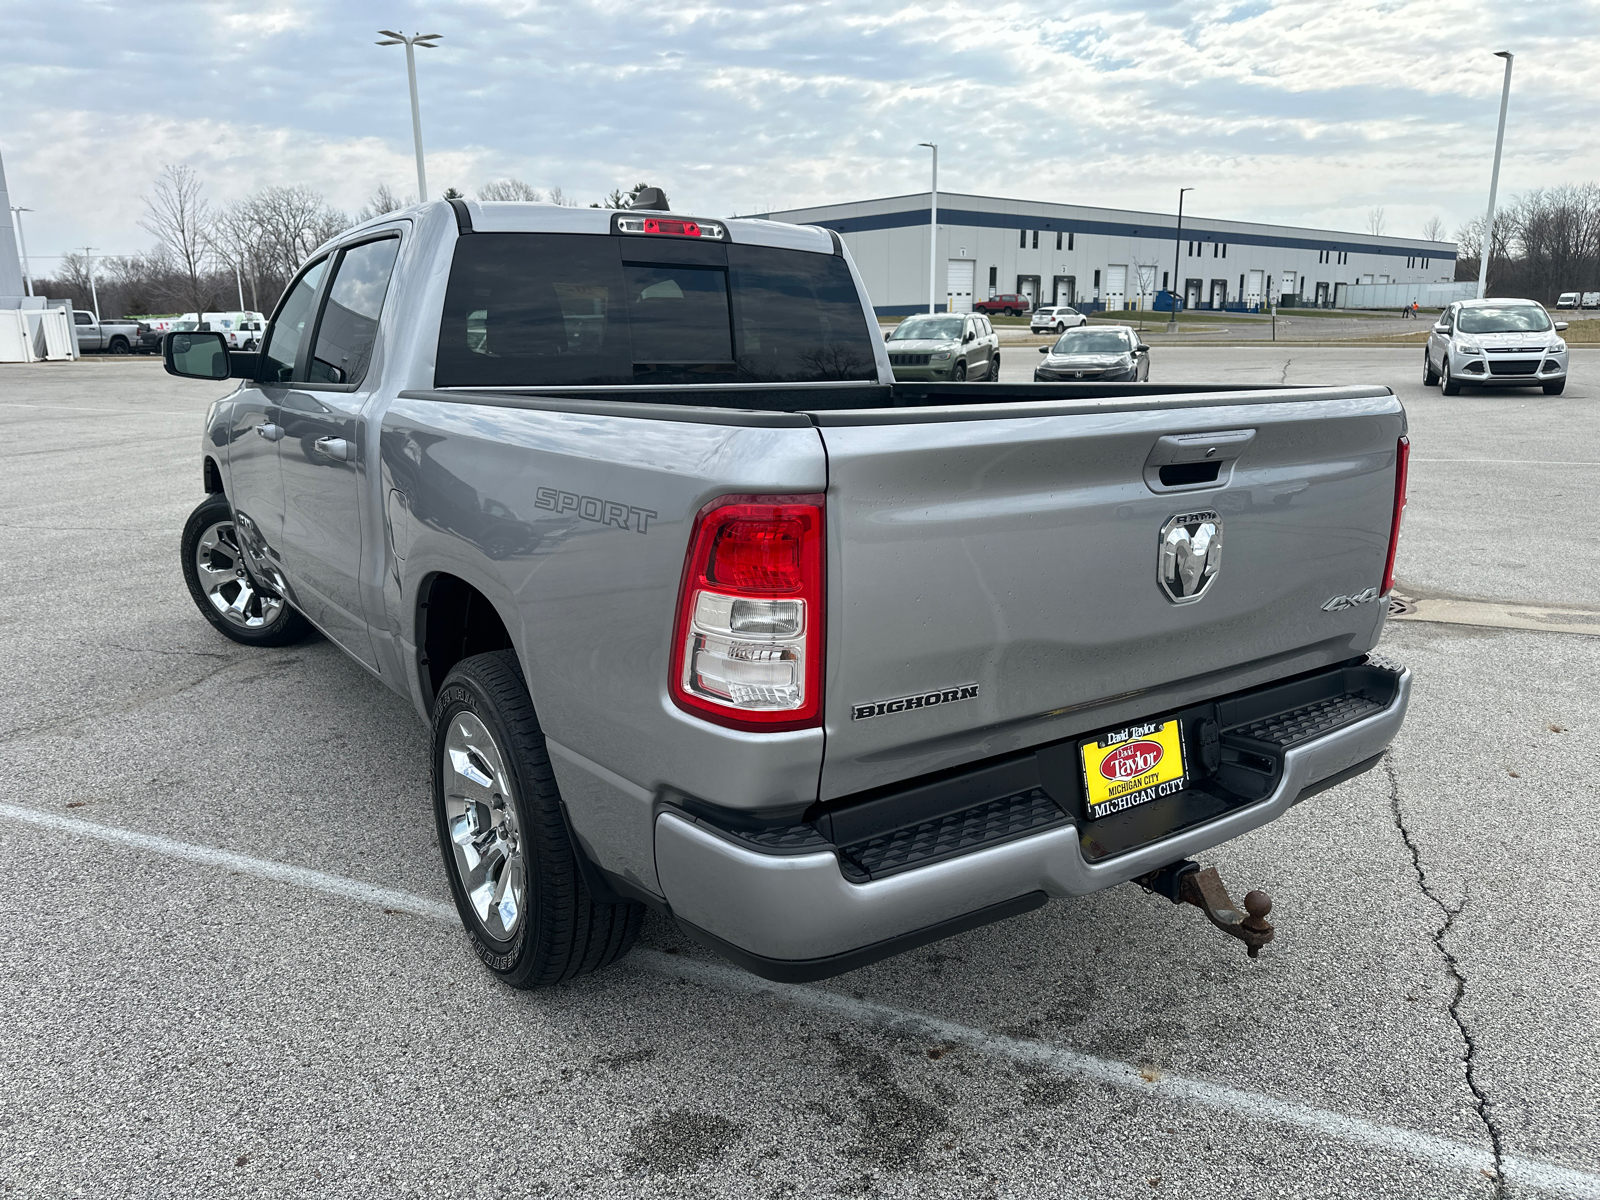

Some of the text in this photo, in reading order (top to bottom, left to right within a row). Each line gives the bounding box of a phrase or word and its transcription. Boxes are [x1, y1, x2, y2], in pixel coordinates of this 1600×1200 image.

[534, 486, 658, 534] SPORT
[1176, 511, 1216, 524] RAM
[851, 682, 979, 721] BIGHORN
[1107, 723, 1156, 745] David Taylor
[1111, 751, 1157, 778] Taylor
[1116, 746, 1134, 759] David
[1094, 778, 1184, 818] MICHIGAN CITY
[1108, 772, 1160, 798] MICHIGAN CITY
